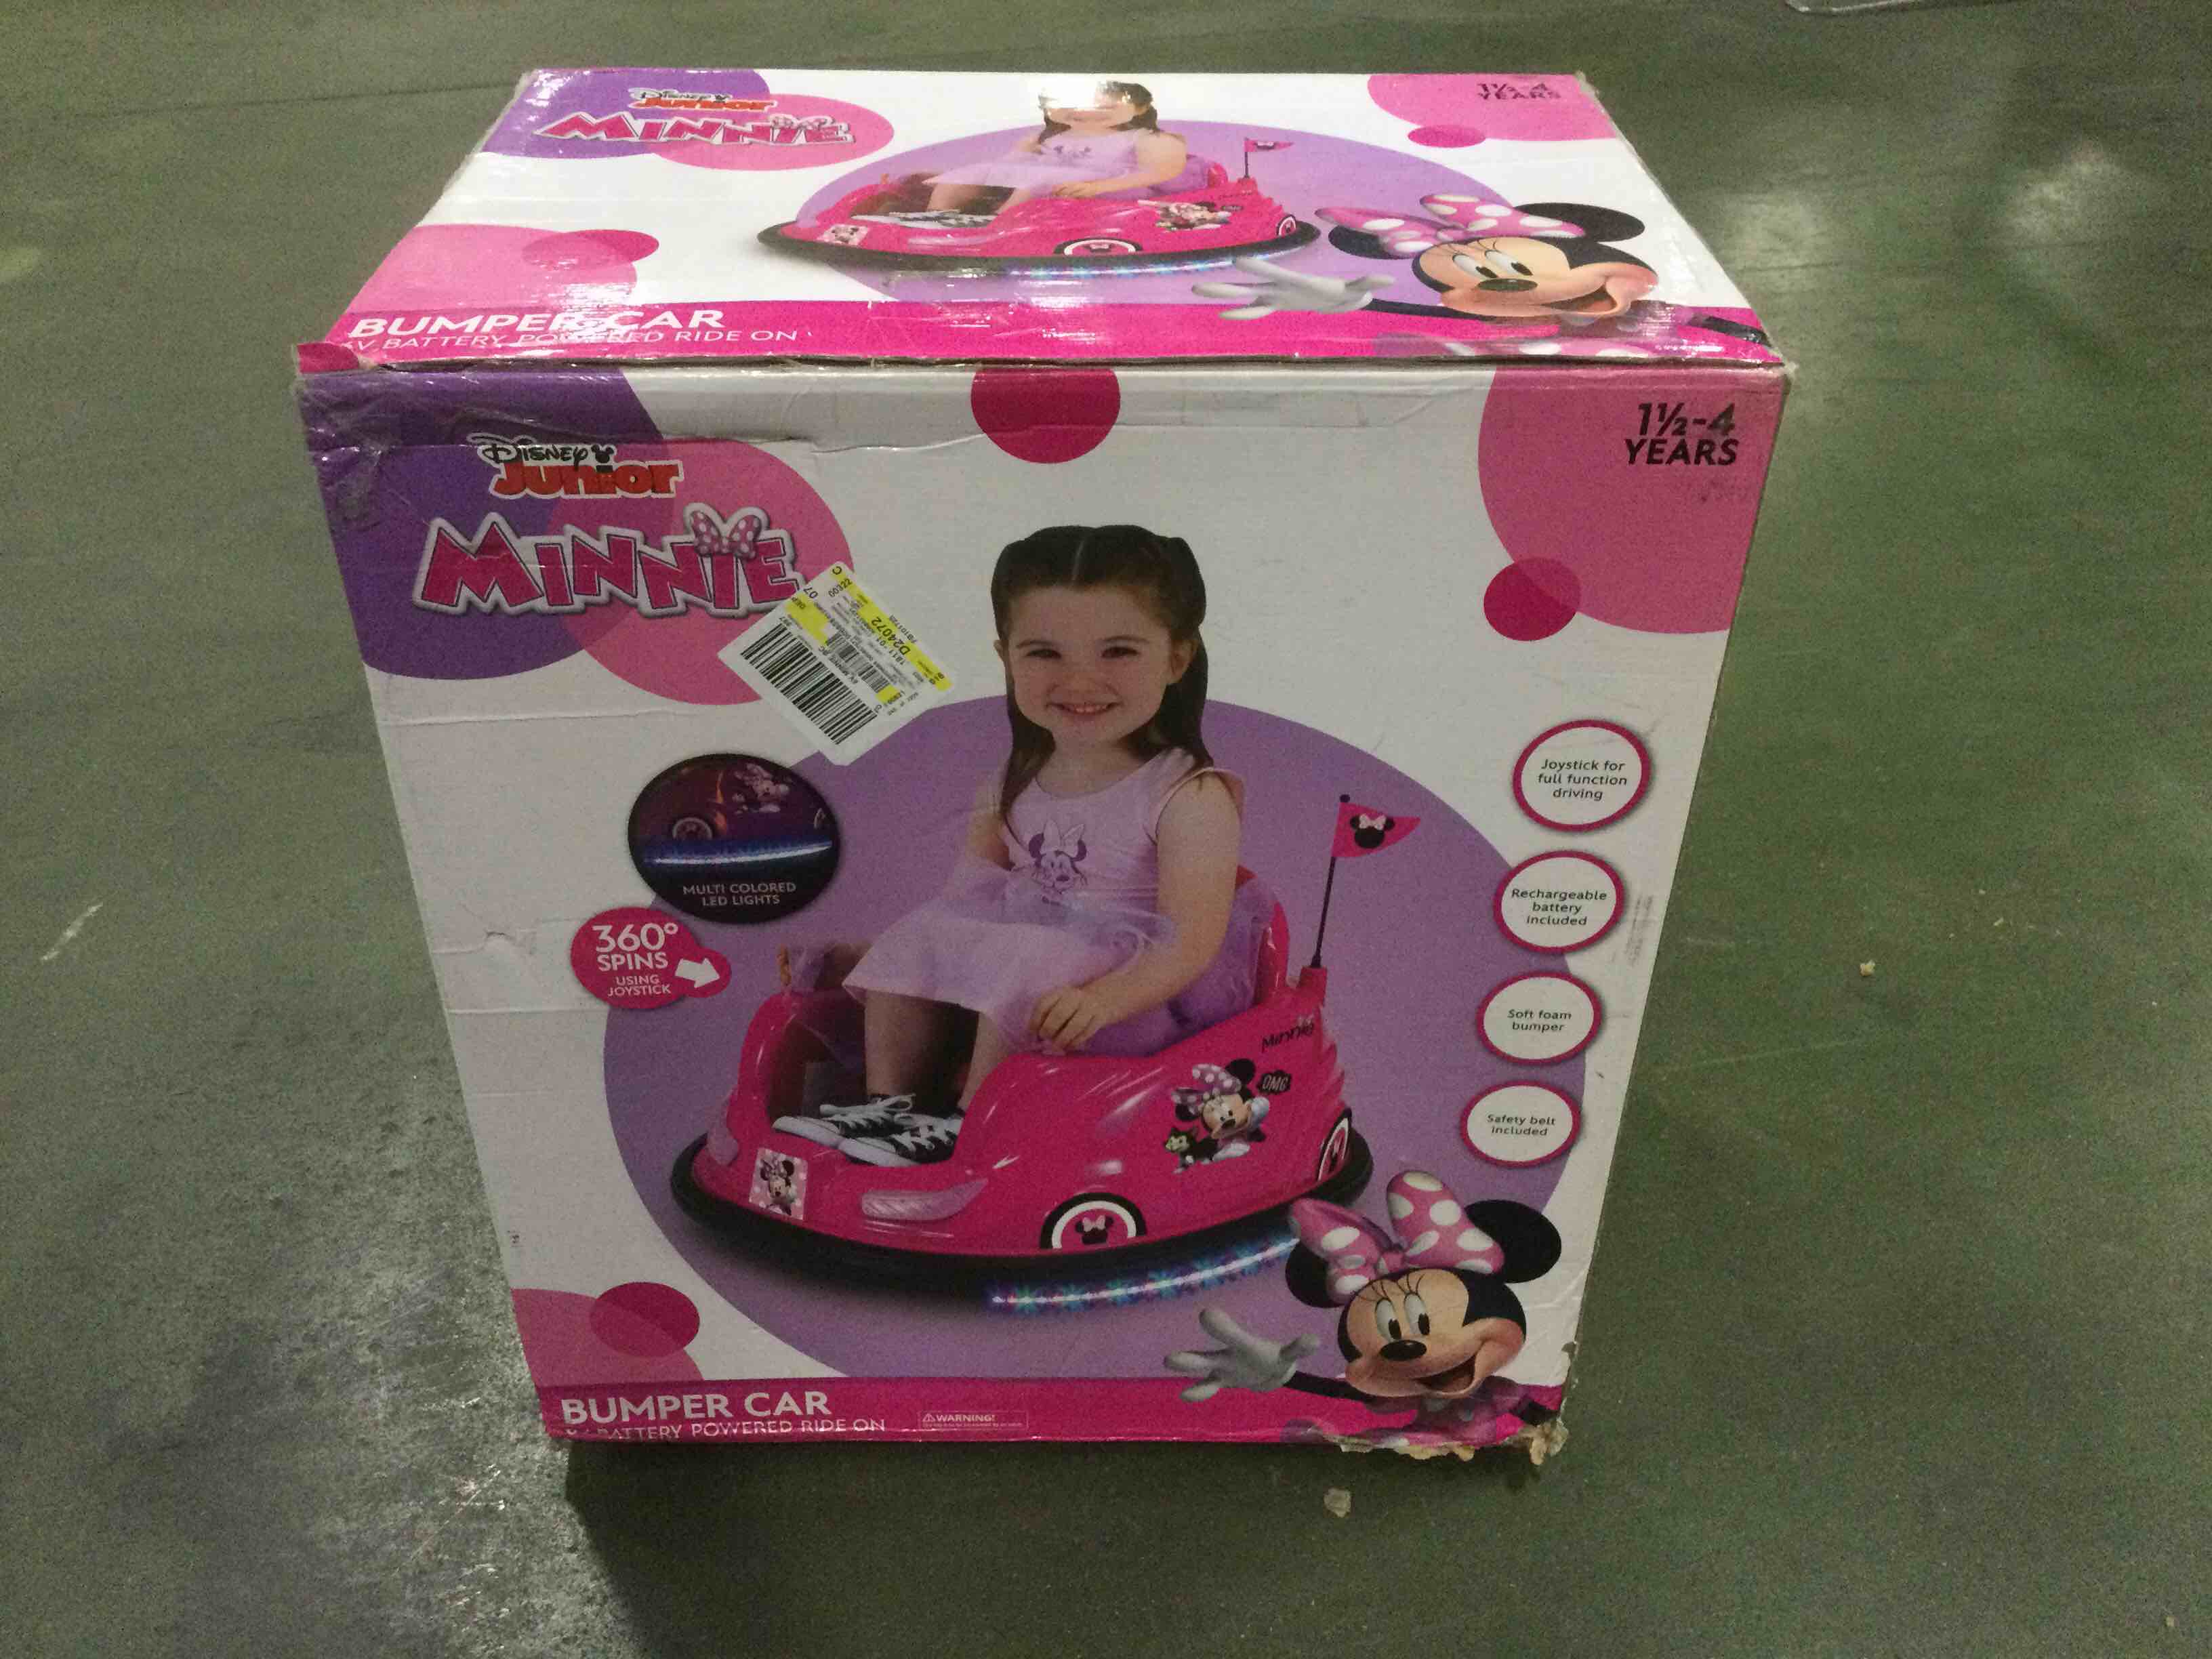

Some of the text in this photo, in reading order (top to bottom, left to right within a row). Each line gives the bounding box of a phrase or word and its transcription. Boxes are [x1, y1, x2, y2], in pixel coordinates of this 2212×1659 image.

[533, 112, 855, 145] MINNIE
[348, 310, 726, 338] BUMPER CAR
[382, 334, 507, 350] BATTERY
[518, 330, 664, 344] PORED
[674, 330, 743, 341] RIDE
[751, 330, 797, 341] ON
[1625, 438, 1740, 465] YEARS
[415, 514, 805, 612] MINNIE
[870, 616, 912, 657] D24072
[1541, 758, 1625, 773] Joystick for
[1538, 773, 1627, 785] full function
[1553, 787, 1603, 801] driving
[683, 882, 797, 895] MULTI COLORED
[1511, 888, 1607, 902] Rechargeable
[702, 893, 780, 907] LED LIGHTS
[1532, 902, 1582, 914] battery
[1526, 915, 1588, 926] included
[597, 951, 669, 971] SPINS
[615, 974, 661, 987] USING
[607, 984, 672, 997] JOYSTICK
[1507, 1008, 1572, 1021] Soft foam
[1512, 1021, 1566, 1033] bumper
[1261, 1073, 1290, 1090] OMG
[1487, 1113, 1557, 1126] Safety belt
[1491, 1126, 1549, 1136] included
[560, 1390, 832, 1425] BUMPER CAR
[691, 1419, 793, 1437] POWERED
[800, 1418, 846, 1433] RIDE
[853, 1418, 886, 1433] ON
